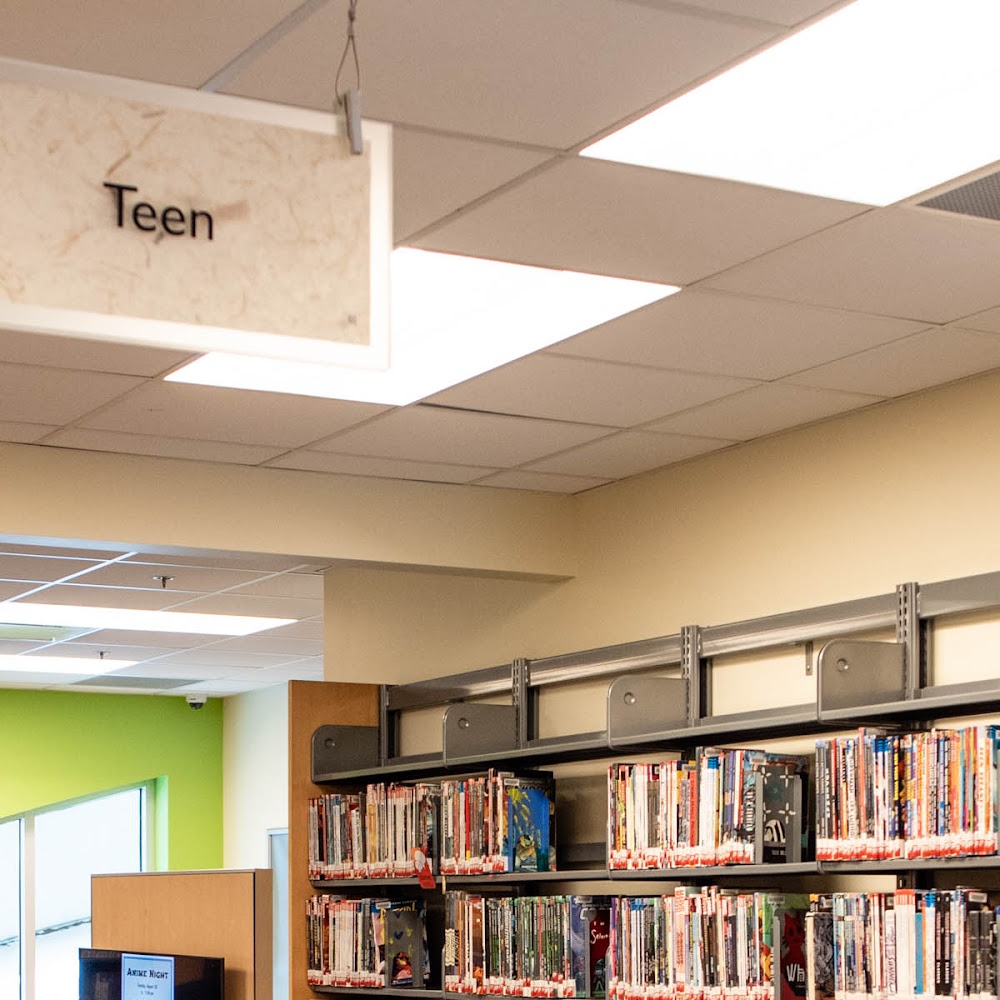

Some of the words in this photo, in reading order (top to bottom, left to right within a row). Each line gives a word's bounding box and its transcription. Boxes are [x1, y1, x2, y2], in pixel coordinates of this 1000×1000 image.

[103, 182, 214, 241] Teen
[127, 968, 147, 977] ANIME
[149, 970, 168, 979] NIGHT
